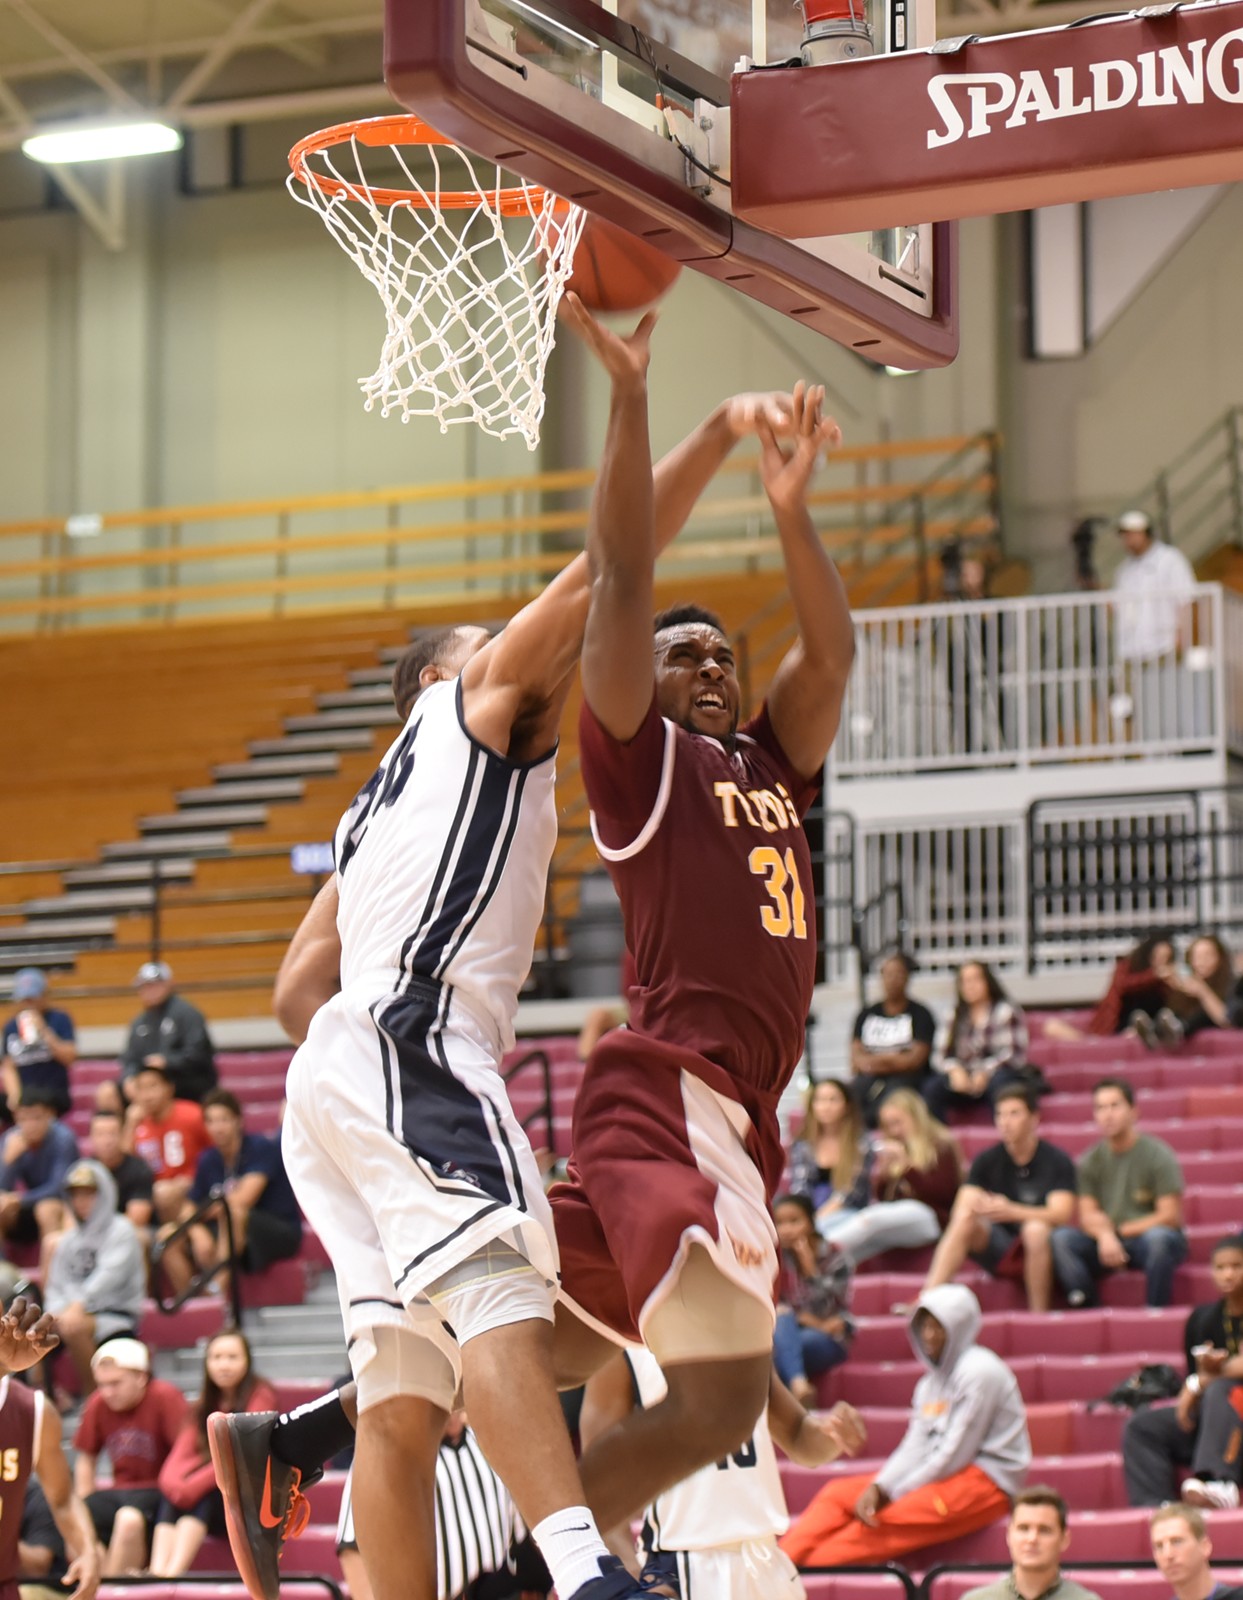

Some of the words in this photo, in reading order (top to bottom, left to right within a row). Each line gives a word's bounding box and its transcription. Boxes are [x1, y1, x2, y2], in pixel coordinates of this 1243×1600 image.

[927, 26, 1243, 149] SPALDING
[748, 846, 807, 940] 31
[0, 1447, 19, 1482] S
